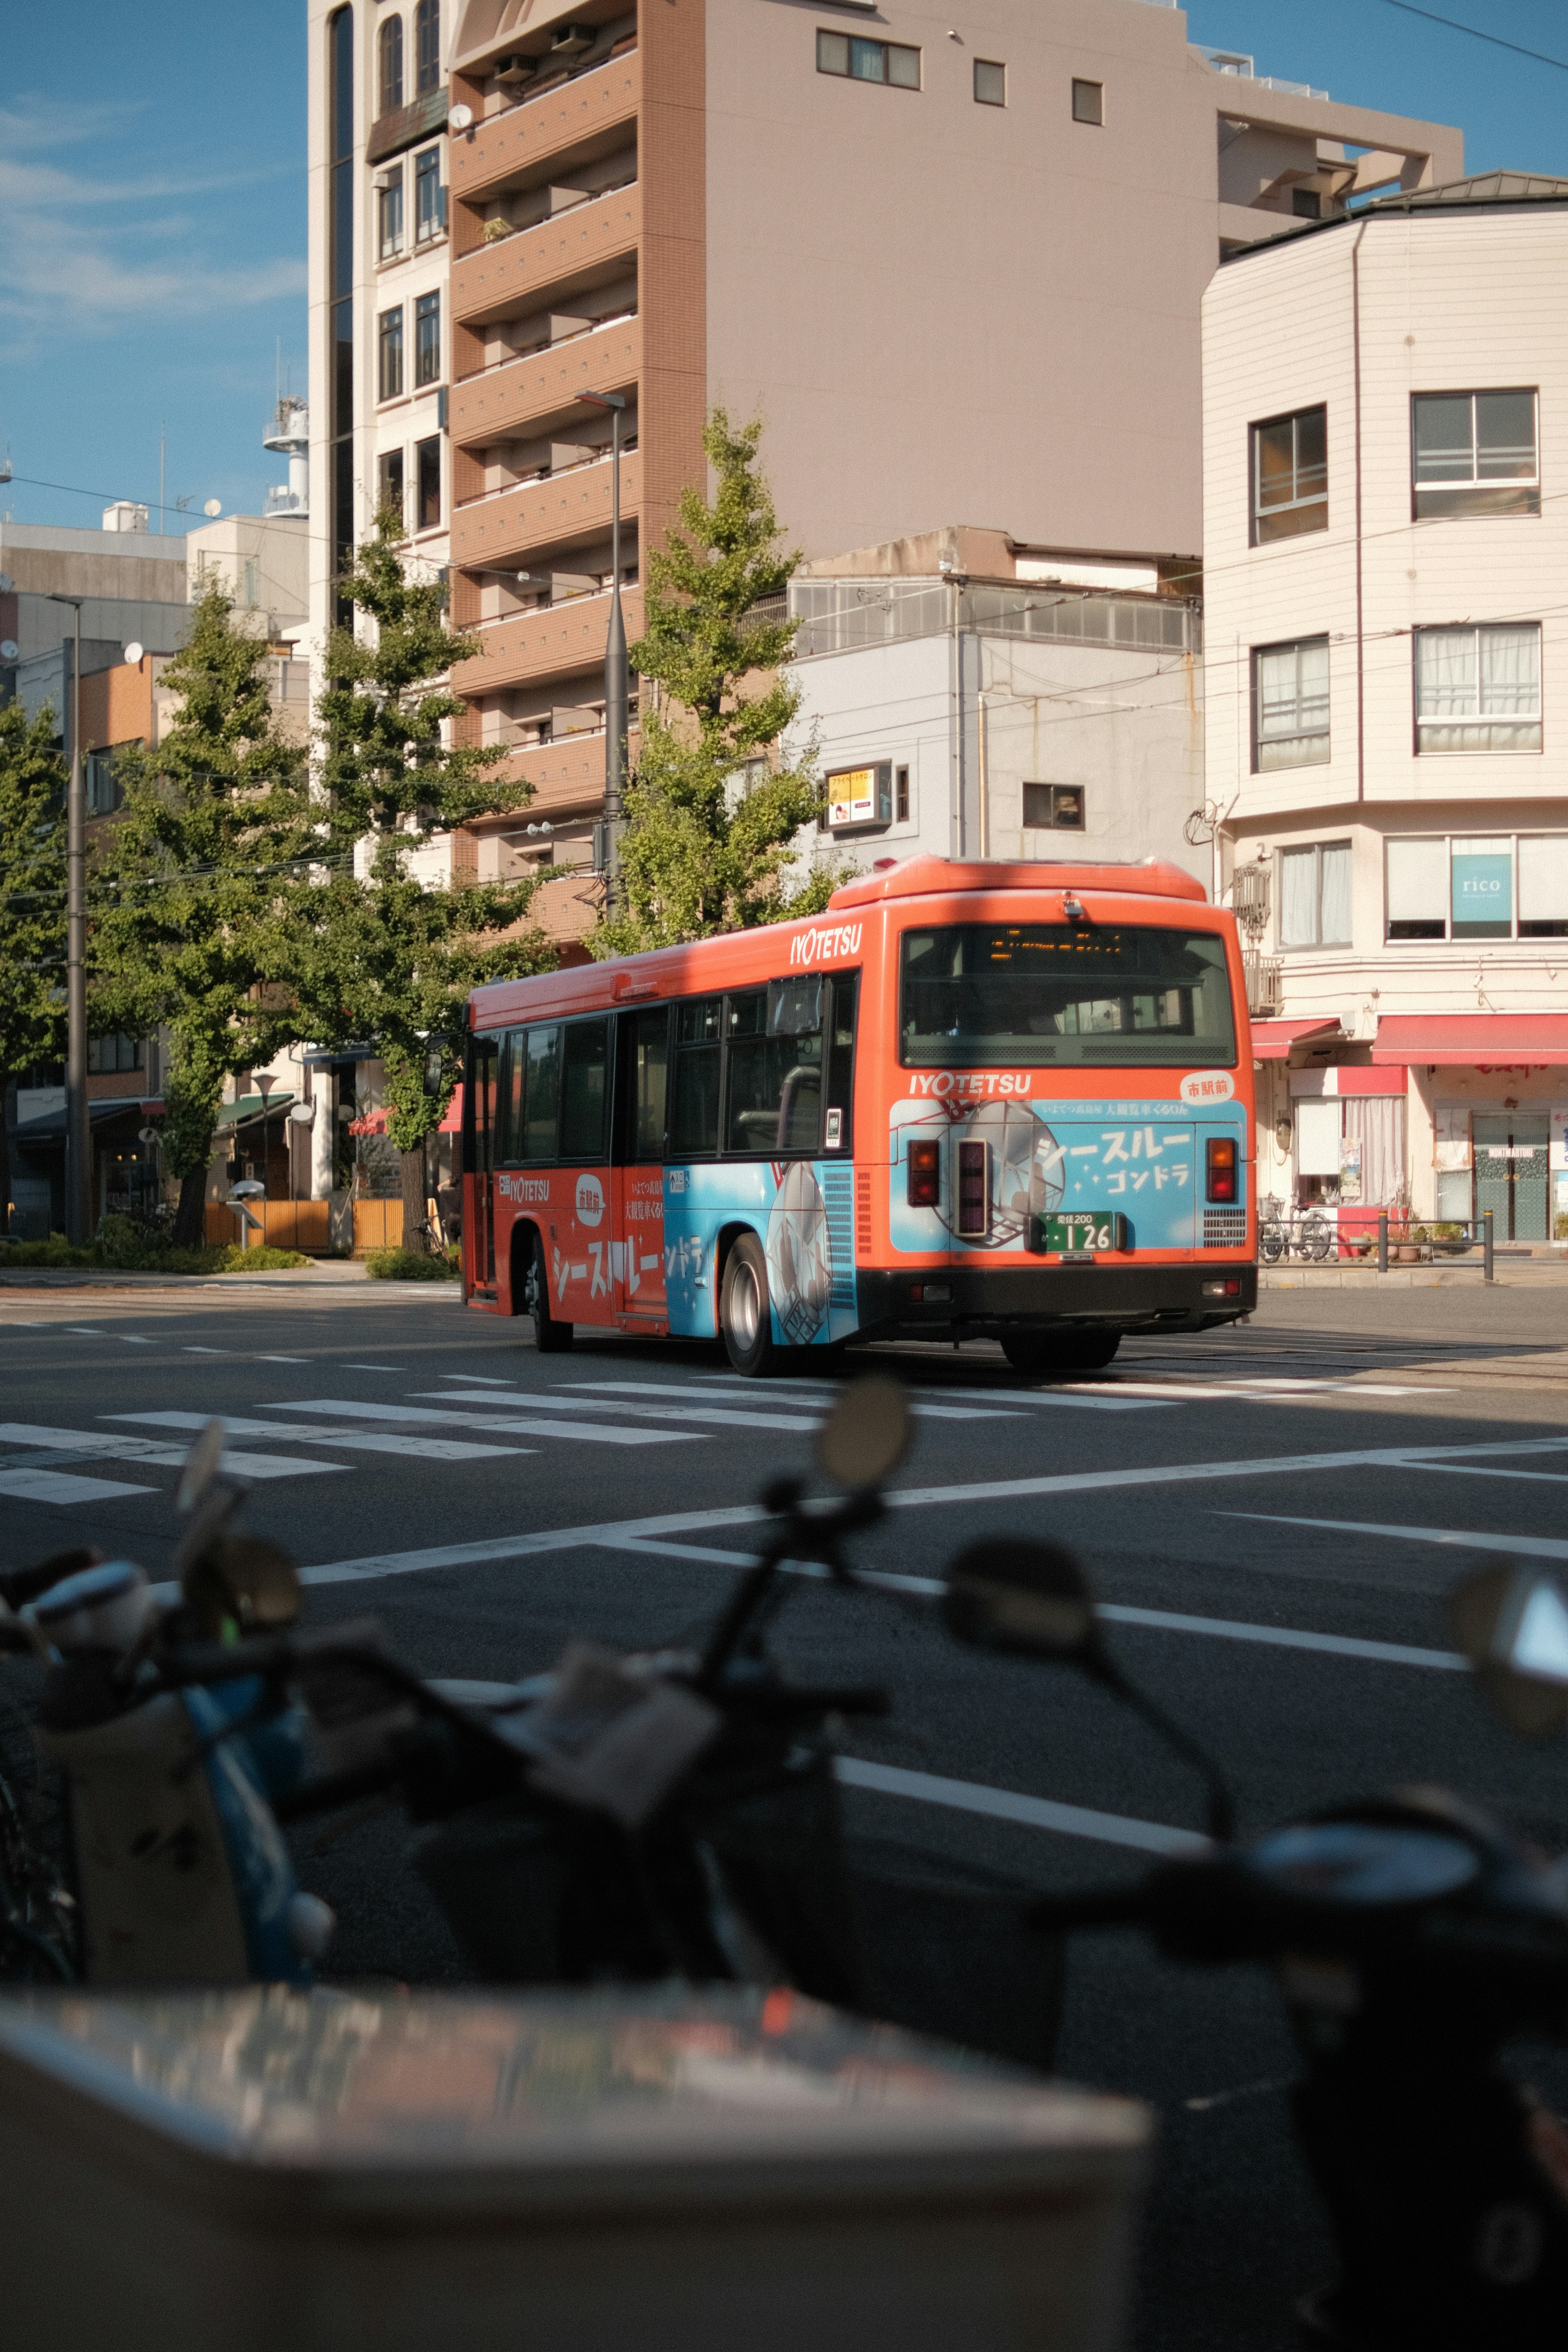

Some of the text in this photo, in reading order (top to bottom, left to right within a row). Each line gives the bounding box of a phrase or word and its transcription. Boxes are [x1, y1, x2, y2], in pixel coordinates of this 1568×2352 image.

[1463, 877, 1500, 891] rico
[790, 923, 863, 965] IYOTETSU
[909, 1072, 1032, 1096] IYOTETSU
[1187, 1078, 1228, 1097] 市駅前
[1036, 1127, 1191, 1170] シースルー
[510, 1176, 550, 1203] IYOTETSU
[1107, 1163, 1189, 1194] ゴンドラ
[579, 1187, 600, 1215] 市駅前
